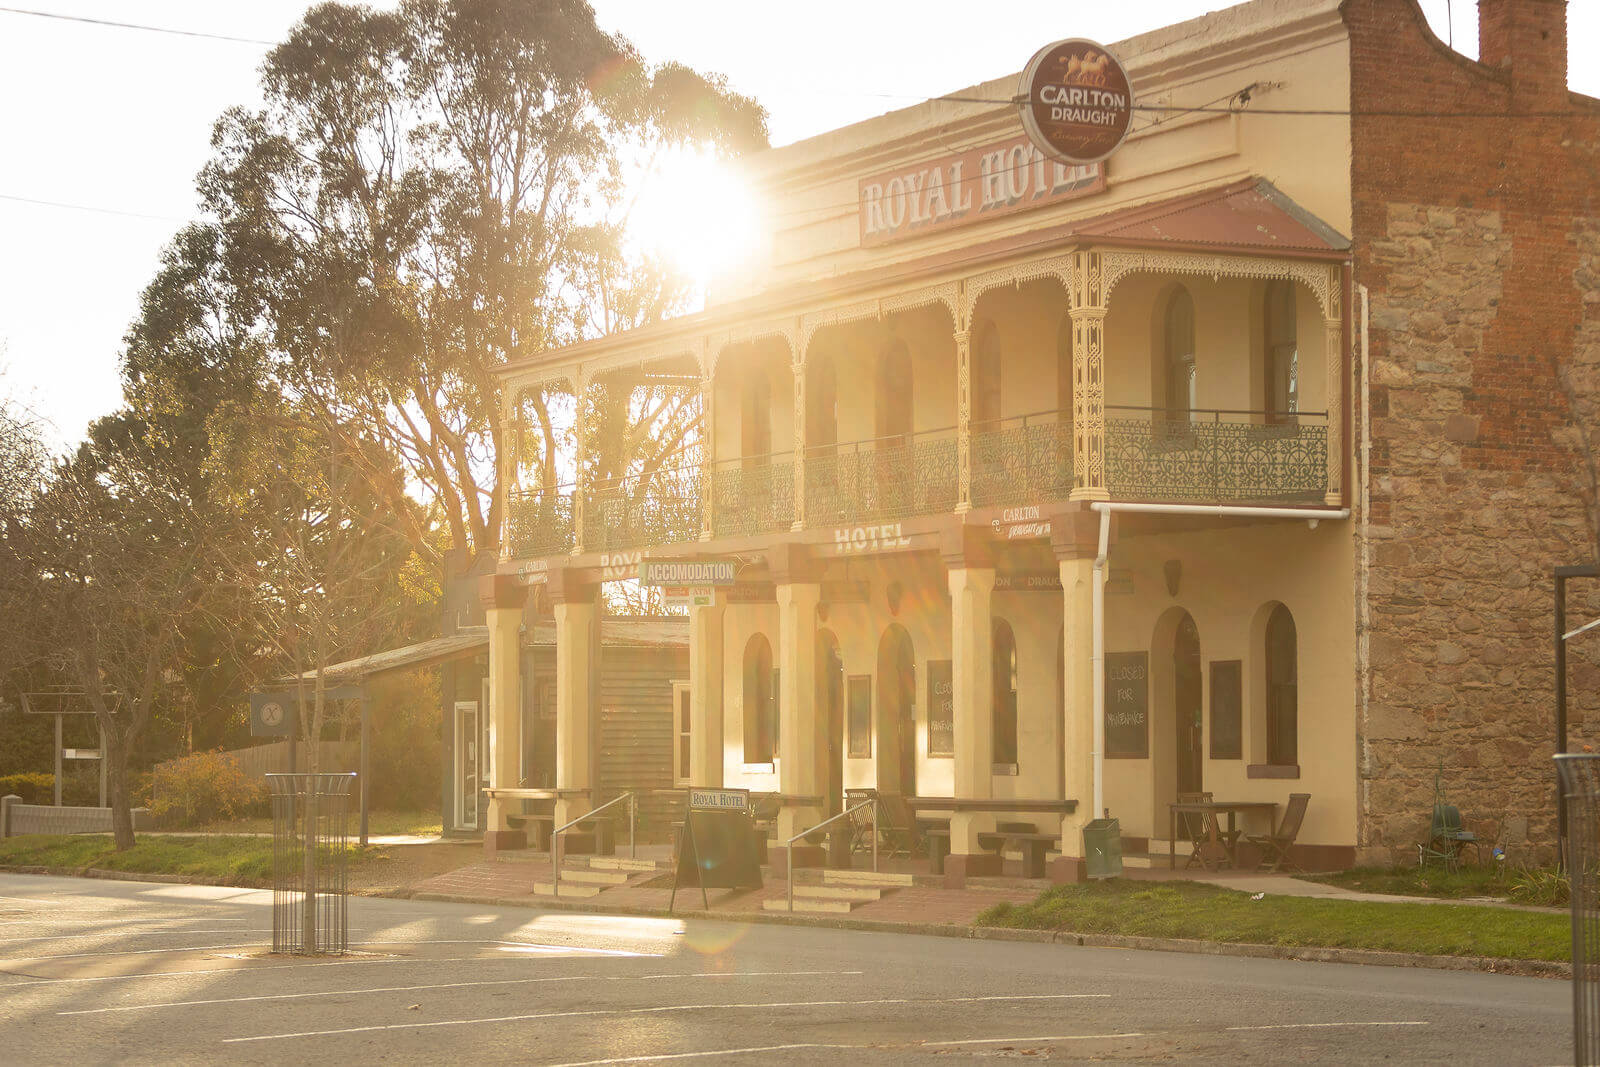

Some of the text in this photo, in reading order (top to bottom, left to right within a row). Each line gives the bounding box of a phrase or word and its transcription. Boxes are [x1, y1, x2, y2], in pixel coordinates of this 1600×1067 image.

[1040, 85, 1125, 111] CARLTON
[1052, 107, 1116, 126] DRAUGHT
[863, 161, 972, 234] ROYAL
[1003, 505, 1040, 521] CARLTON
[834, 522, 911, 553] HOTEL
[600, 550, 650, 579] ROYA
[647, 562, 734, 581] ACCOMODATION
[1028, 576, 1061, 587] DRAUG
